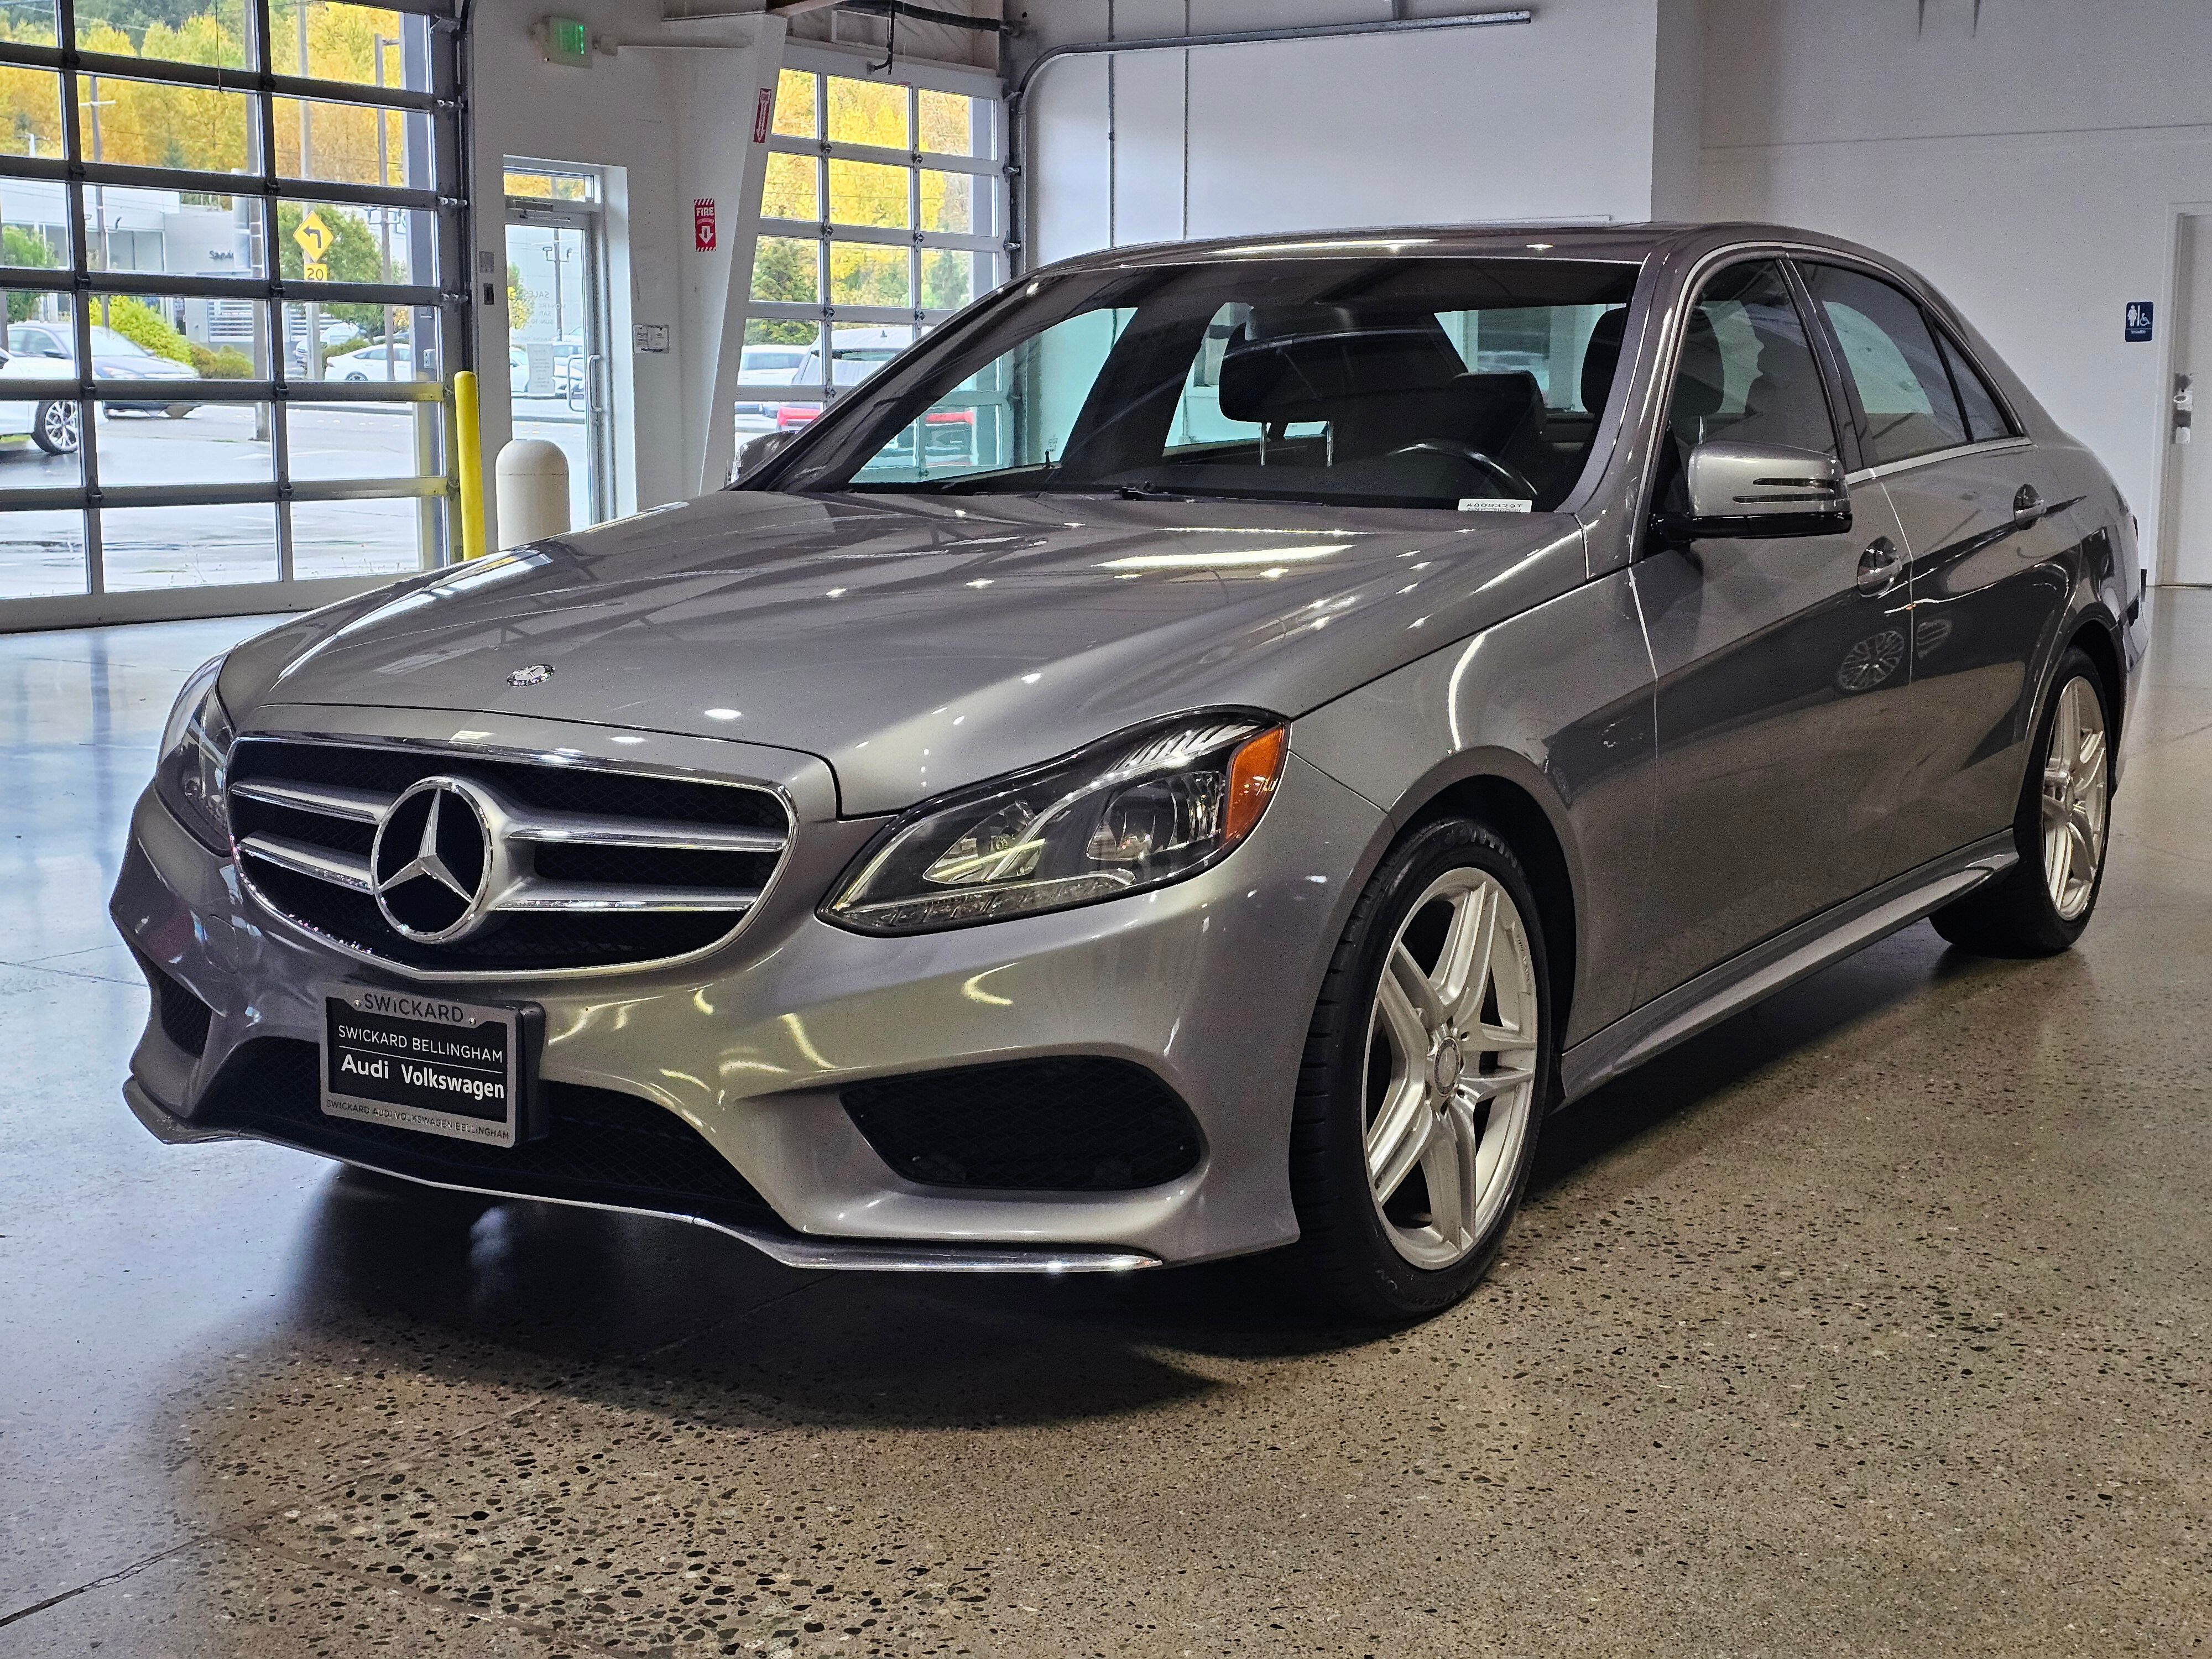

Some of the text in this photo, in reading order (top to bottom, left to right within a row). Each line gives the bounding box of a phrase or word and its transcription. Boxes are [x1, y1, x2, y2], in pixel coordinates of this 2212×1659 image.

[696, 207, 714, 216] FIRE
[307, 268, 324, 281] 20
[338, 1025, 503, 1063] SWICKARD BELLINGHAM
[341, 1053, 504, 1100] Audi Volkswagen
[326, 1099, 509, 1139] SWICKARD AUDI VOLKSWAGEN BELLINGHAM
